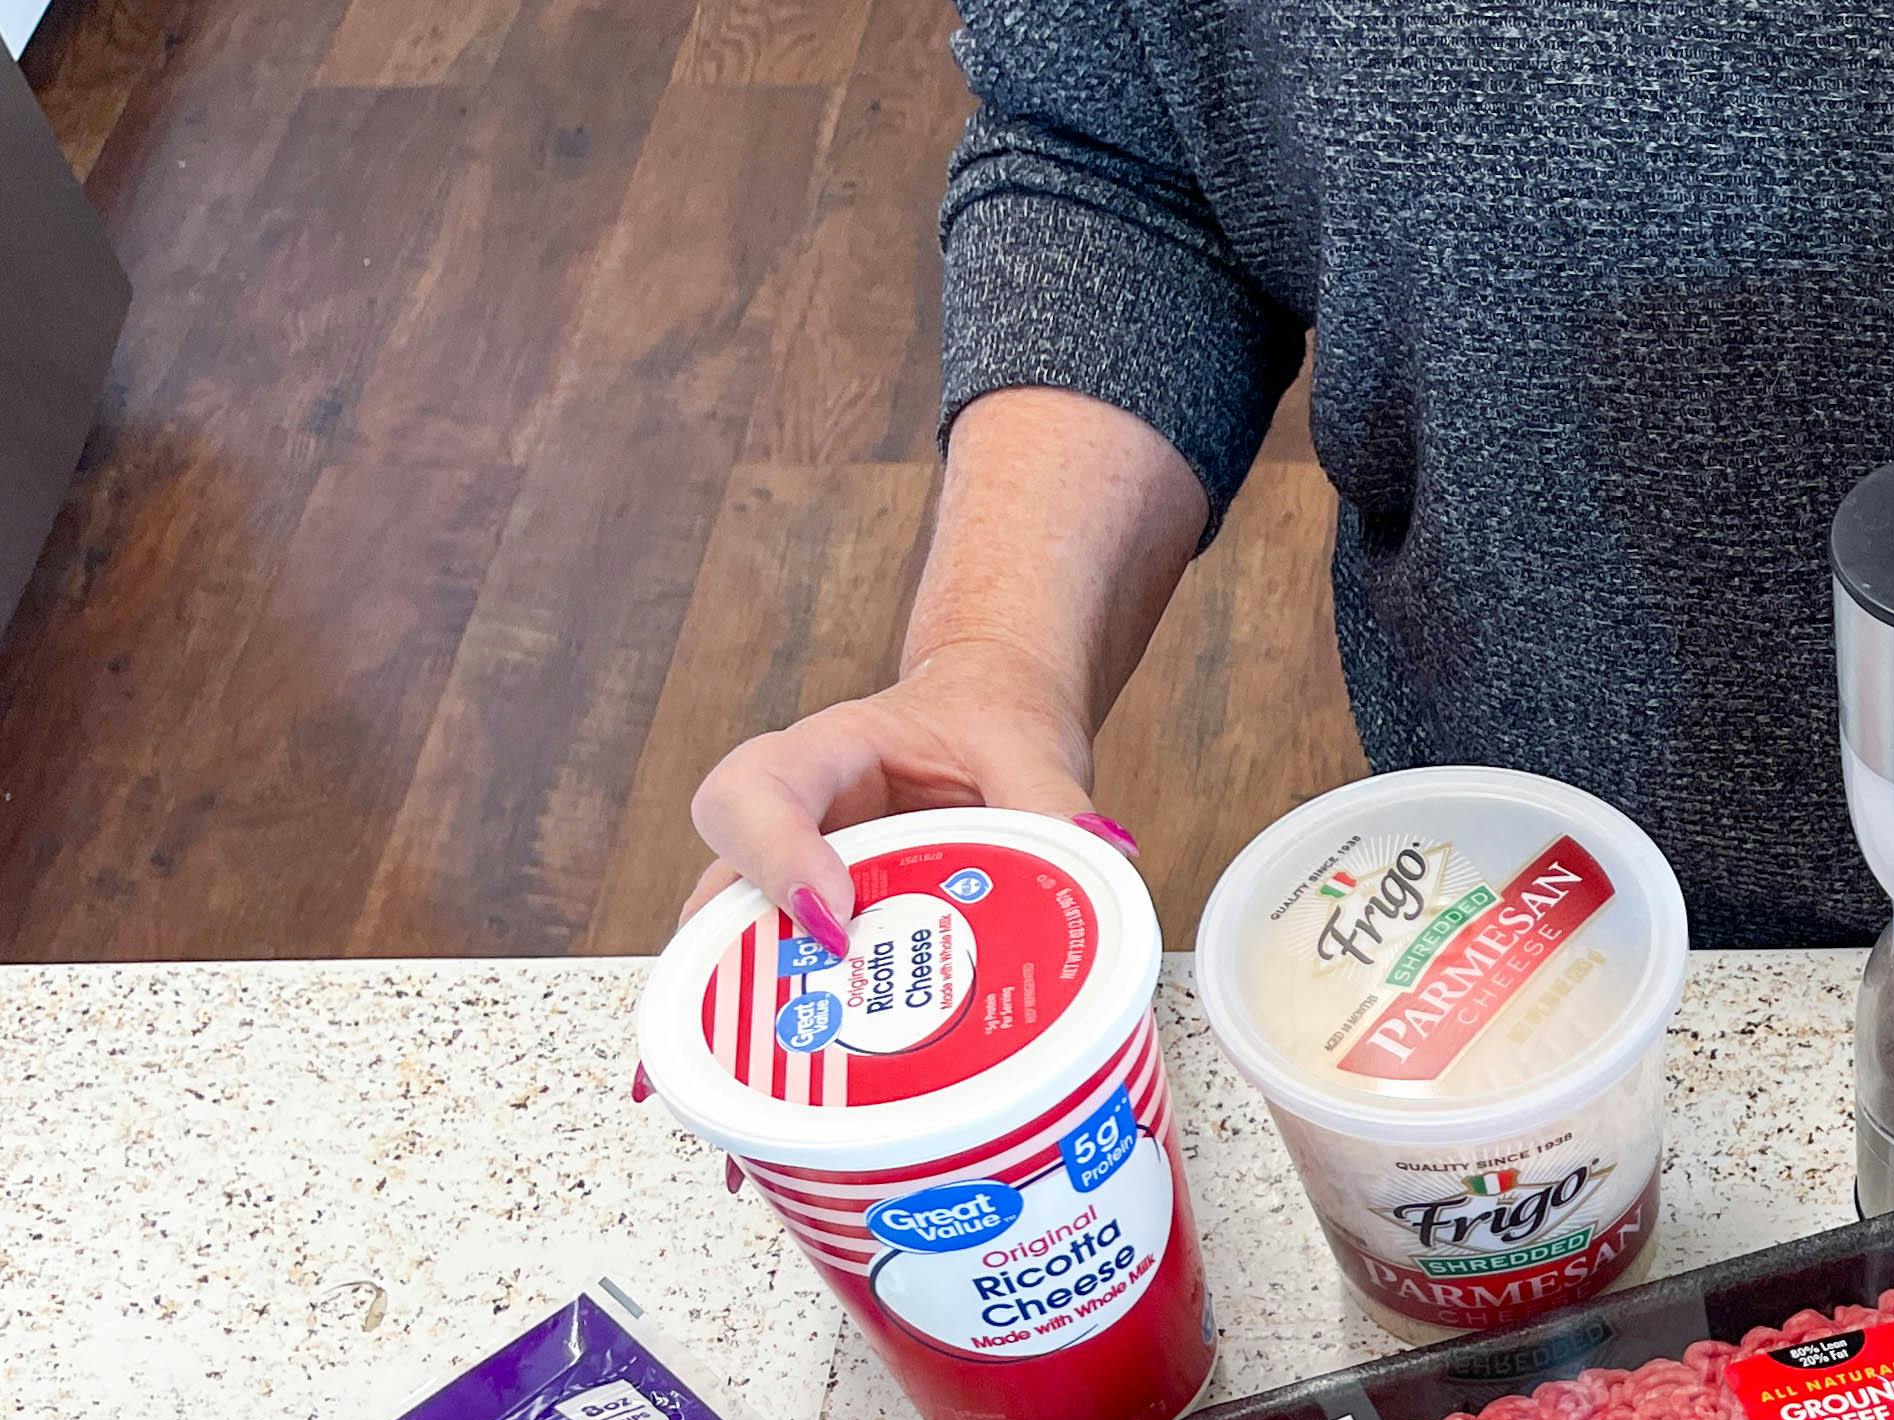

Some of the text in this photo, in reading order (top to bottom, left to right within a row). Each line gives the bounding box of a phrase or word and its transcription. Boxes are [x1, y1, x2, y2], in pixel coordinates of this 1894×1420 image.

[1317, 848, 1427, 966] Frigo
[939, 935, 952, 961] Whole
[1367, 861, 1584, 1064] PARMESAN
[1394, 891, 1489, 984] SHREDDED
[847, 956, 865, 1008] Original
[866, 940, 894, 1014] Ricotta
[905, 928, 931, 1009] Cheese
[939, 982, 952, 1010] Made
[1456, 922, 1564, 1025] CHEESE
[790, 1002, 815, 1048] Great
[812, 998, 830, 1033] Value
[1081, 1133, 1134, 1187] Protein
[1395, 1132, 1573, 1173] QUALITY SINCE 1938
[882, 1192, 1000, 1230] Great
[917, 1213, 1000, 1241] Value
[1393, 1165, 1590, 1248] Frigo
[972, 1219, 1122, 1301] Ricotta
[982, 1204, 1098, 1269] Original
[1359, 1203, 1644, 1309] PARMESAN
[1429, 1232, 1585, 1274] SHREDDED
[971, 1252, 1155, 1349] Made with Whole Milk
[982, 1244, 1135, 1327] Cheese
[1789, 1339, 1848, 1360] 80% Lean
[1799, 1349, 1849, 1368] 20% Fat
